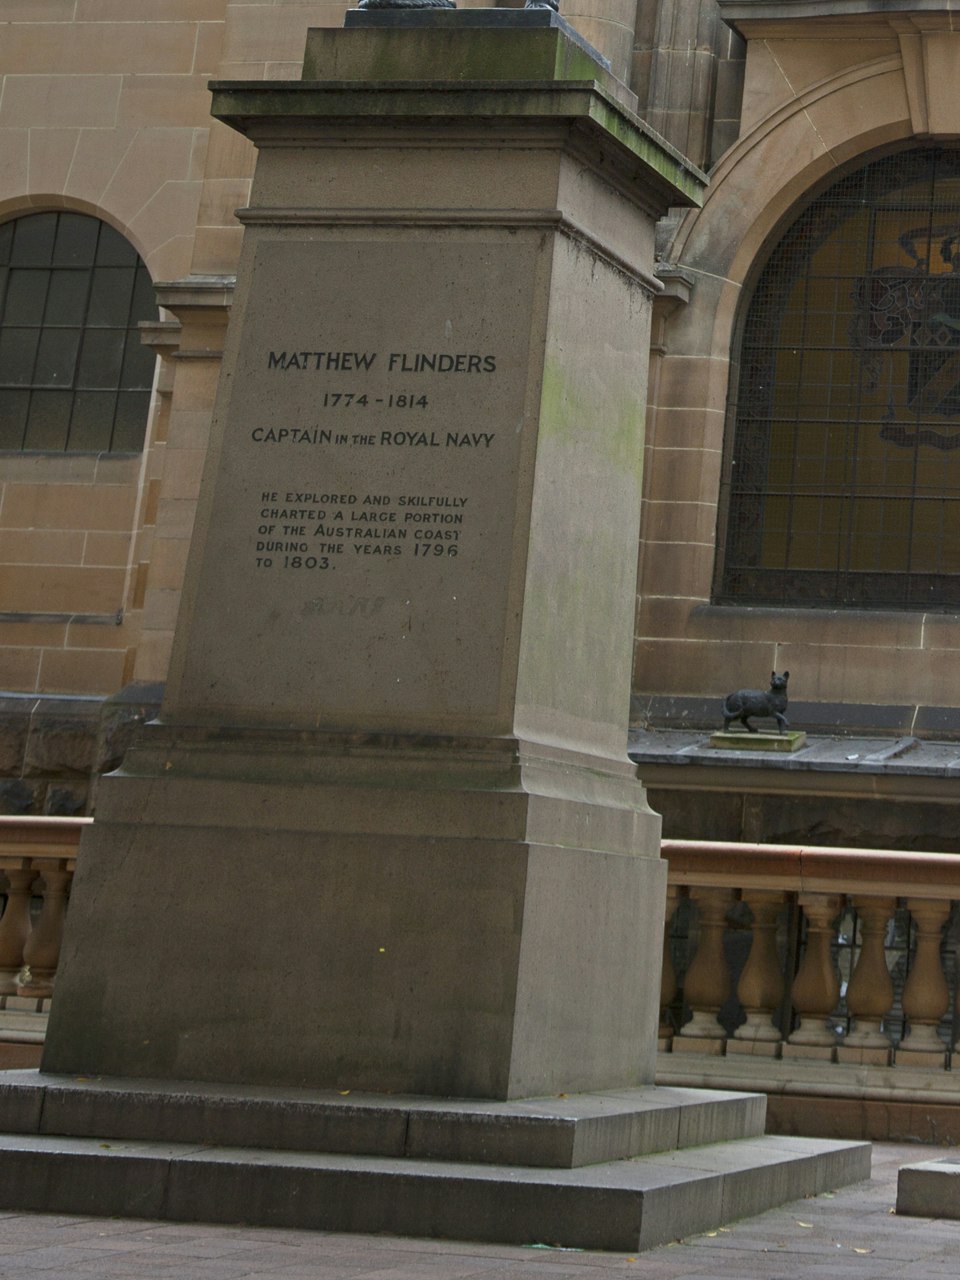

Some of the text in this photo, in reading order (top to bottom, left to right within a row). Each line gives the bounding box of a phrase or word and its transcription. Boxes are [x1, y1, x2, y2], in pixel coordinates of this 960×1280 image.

[268, 351, 497, 373] MATTHEW FLINDERS
[323, 393, 368, 408] 1774
[388, 394, 428, 408] 1814
[252, 428, 495, 448] CAPTAIN IN THE ROYAL NAVY
[261, 492, 468, 508] HE EXPLORED AND SKILFULLY
[260, 509, 463, 524] CHARTED A LARGE PORTION
[258, 524, 461, 540] OF THE AUSTRALIAN COAST
[256, 542, 458, 557] DURING THE YEARS 1796
[256, 556, 336, 570] TO 1803.
